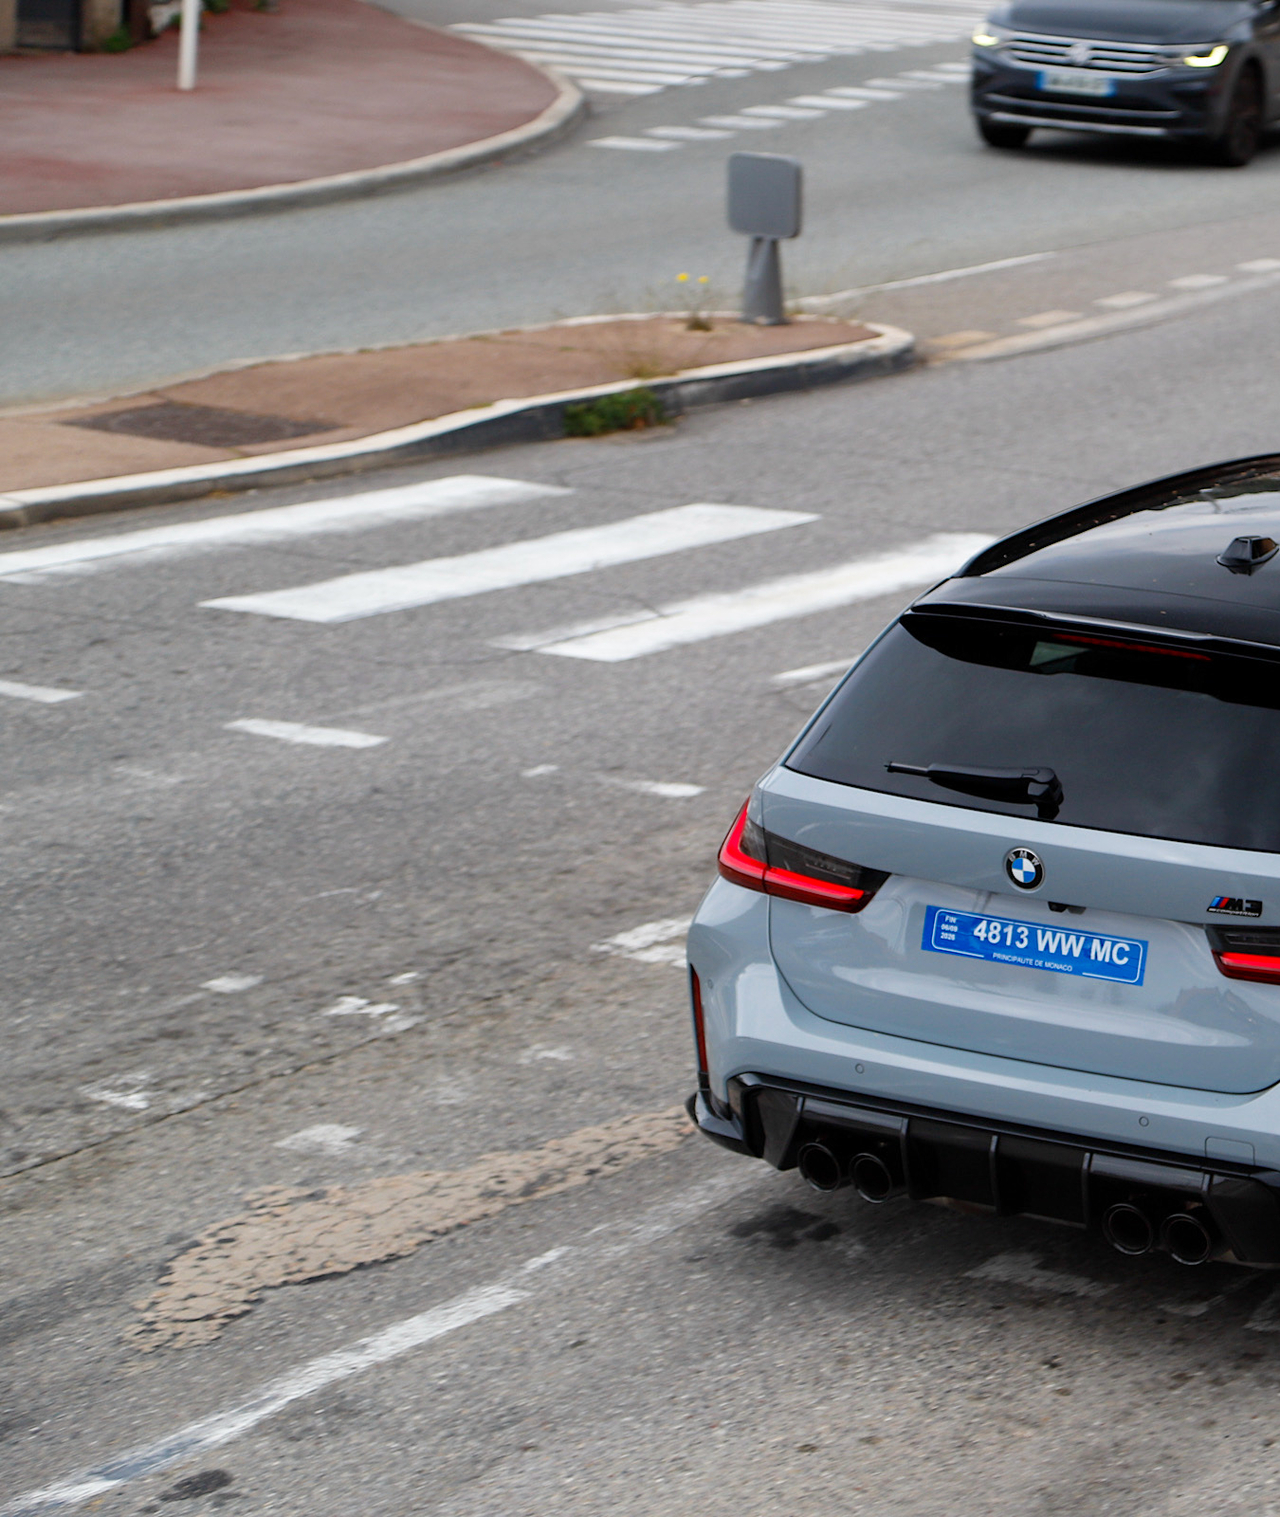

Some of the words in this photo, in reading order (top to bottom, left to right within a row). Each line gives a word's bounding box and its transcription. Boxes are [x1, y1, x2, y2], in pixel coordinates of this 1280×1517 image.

[1220, 897, 1262, 913] M3
[945, 915, 957, 923] FIN
[973, 920, 1029, 949] 4813
[1036, 929, 1086, 957] WW
[1090, 938, 1130, 965] MC
[992, 952, 1033, 966] PRINCIPAUTE
[1044, 961, 1073, 972] MONACO
